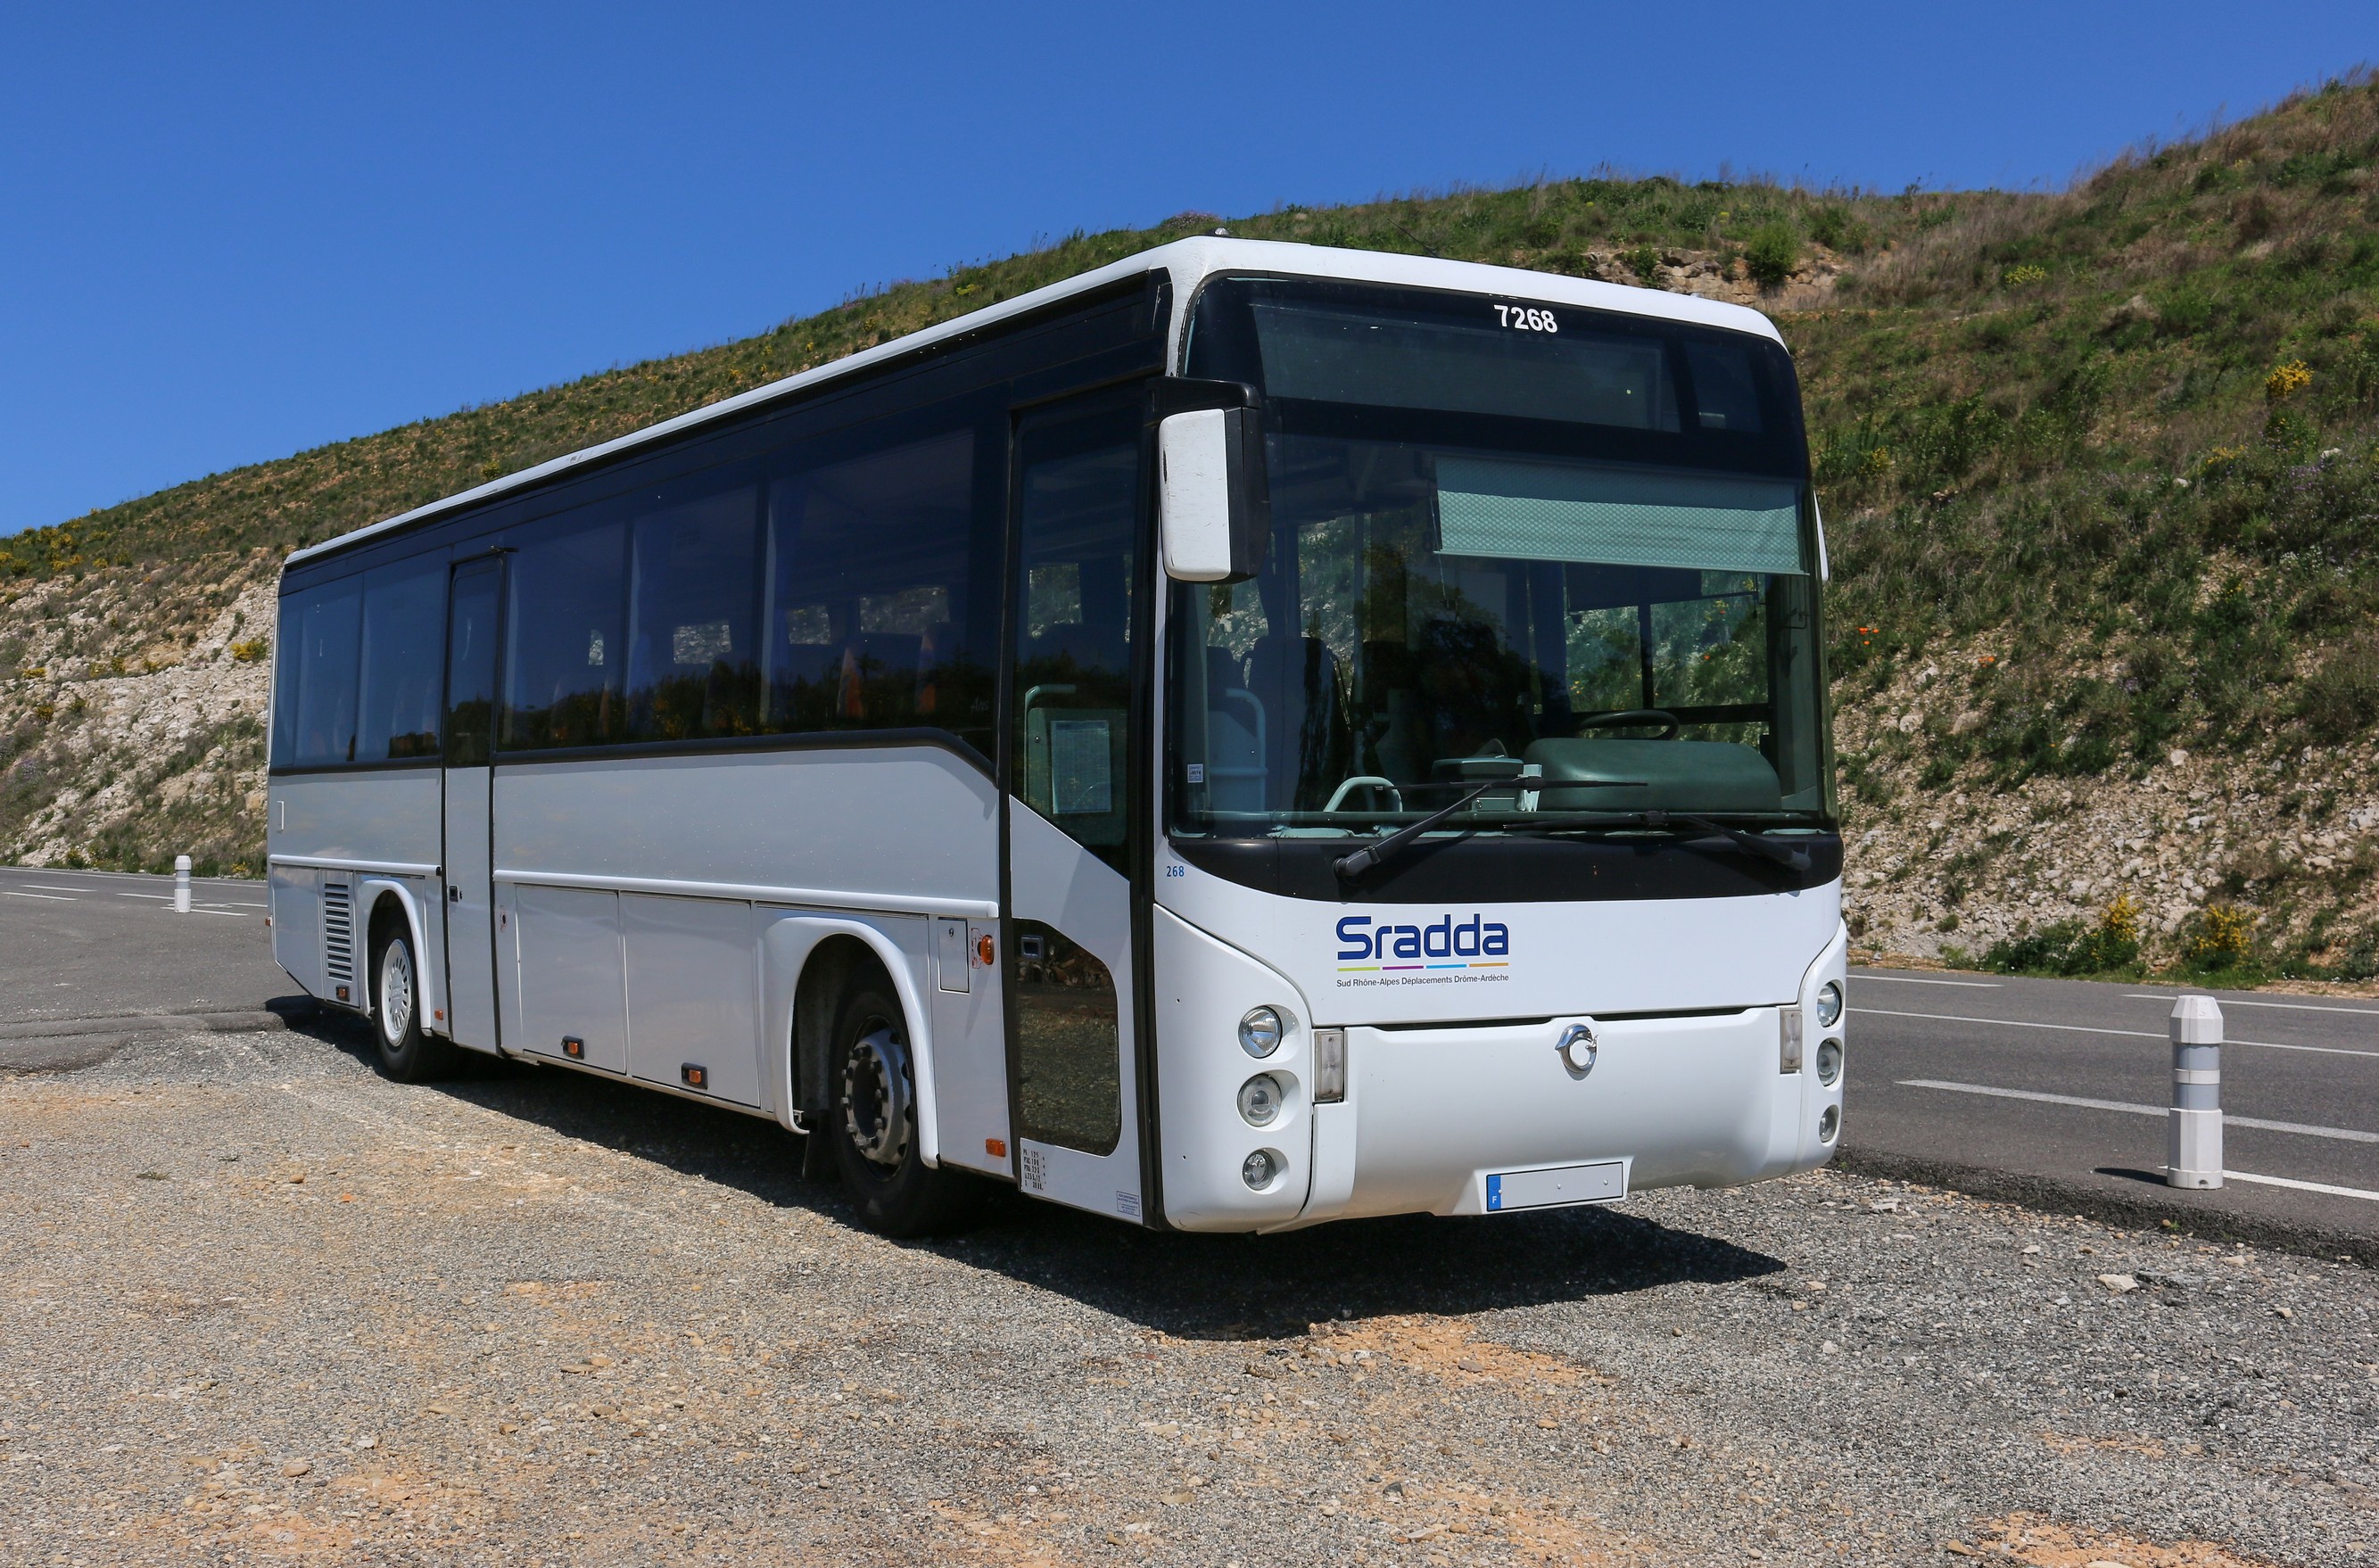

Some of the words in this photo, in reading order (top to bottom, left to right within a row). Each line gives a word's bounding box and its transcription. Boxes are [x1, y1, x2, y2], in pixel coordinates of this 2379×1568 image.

[1493, 304, 1558, 334] 7268
[1166, 865, 1185, 878] 268
[1336, 913, 1509, 960] Sradda
[1336, 978, 1351, 987] Sud
[1352, 978, 1400, 987] Rhône-Alpes
[1401, 975, 1453, 986] Déplacements
[1454, 973, 1509, 983] Drôme-Ardèche
[1491, 1195, 1498, 1204] F
